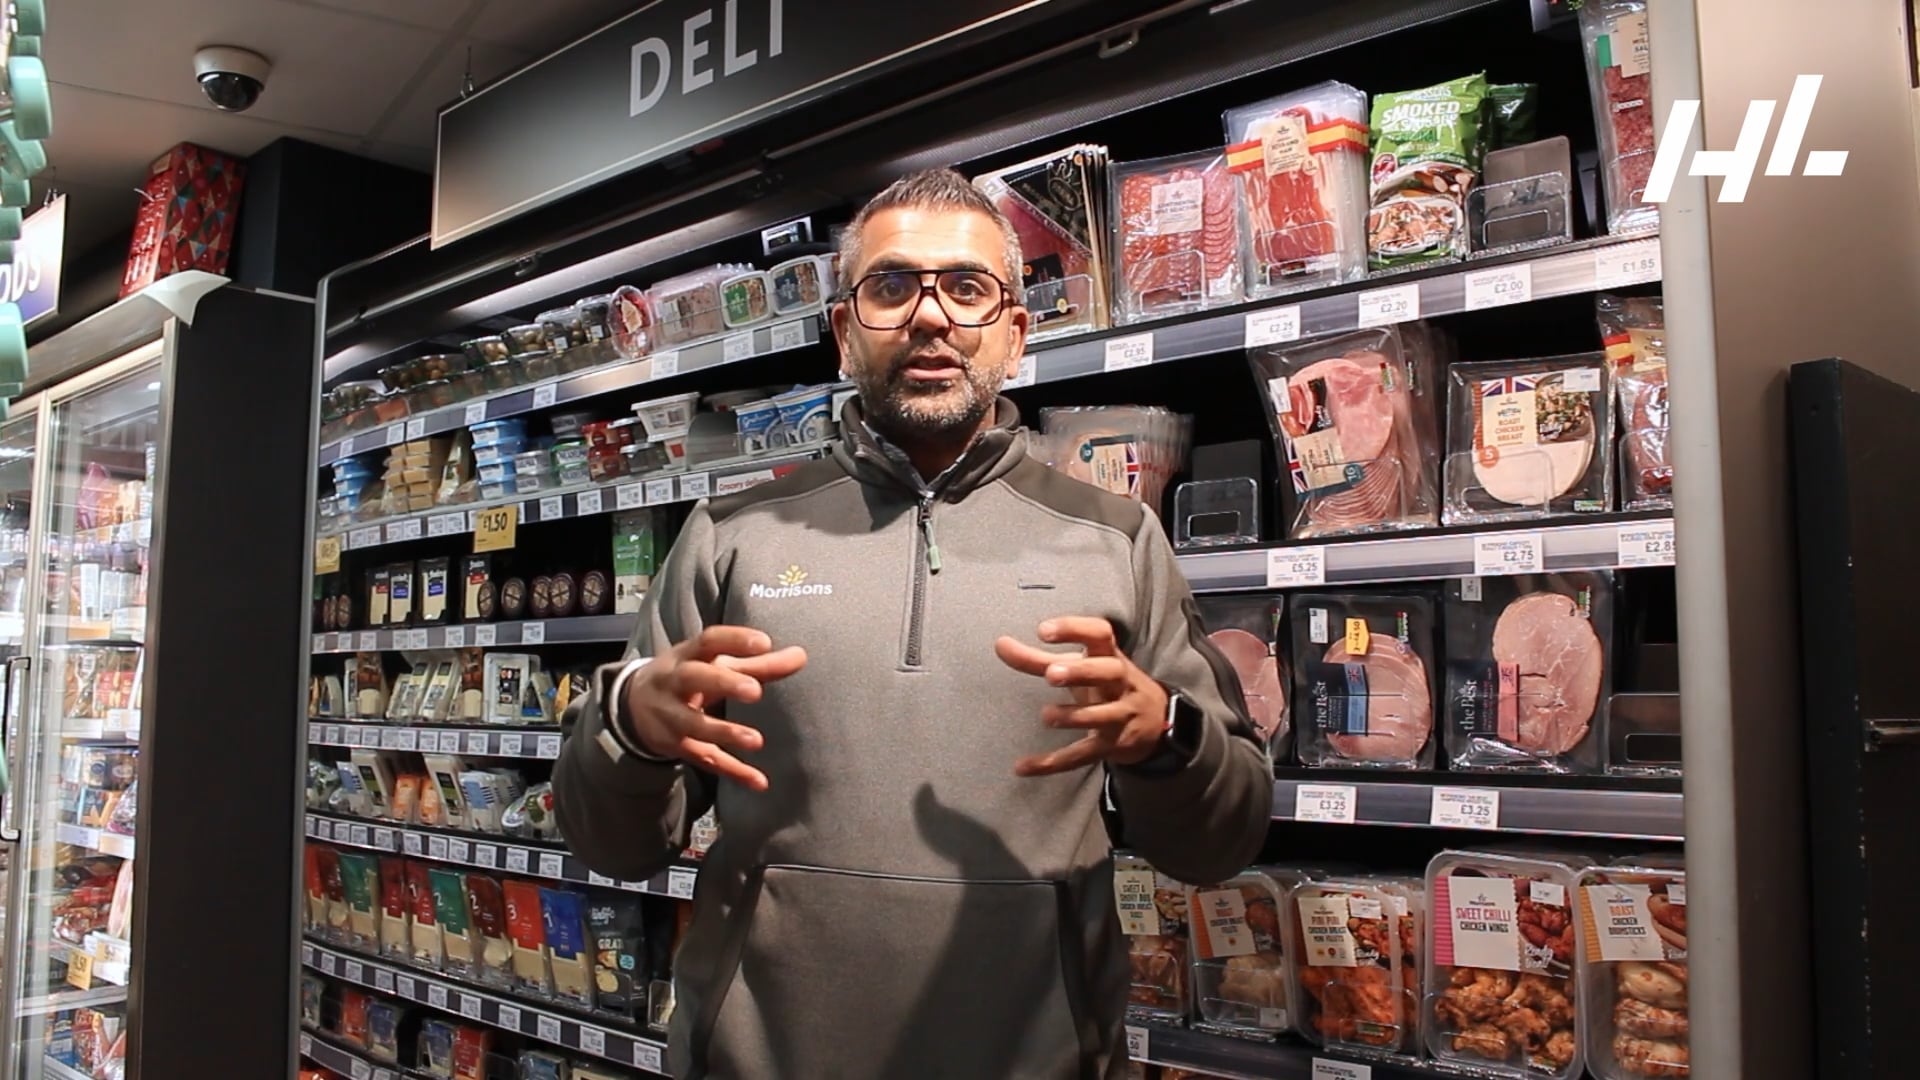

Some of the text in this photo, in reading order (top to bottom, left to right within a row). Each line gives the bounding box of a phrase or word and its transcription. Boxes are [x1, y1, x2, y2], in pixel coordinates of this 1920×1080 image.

[629, 0, 783, 118] DELI
[1381, 101, 1460, 125] SMOKED
[1622, 257, 1656, 273] £1.85
[1494, 280, 1524, 294] £2.00
[1484, 448, 1494, 460] 5
[483, 511, 508, 532] £1.50
[1503, 549, 1534, 561] £2.75
[1291, 562, 1318, 573] £5.25
[749, 583, 833, 599] Morrisons
[1458, 679, 1478, 731] the Best
[1319, 799, 1347, 811] £3.25
[1460, 804, 1490, 817] £3.25
[507, 904, 518, 920] 3
[1456, 907, 1512, 922] SWEET CHILLI
[1609, 905, 1635, 917] ROAST
[1460, 921, 1509, 933] CHICKEN WINGS
[1612, 917, 1638, 926] CHICKEN
